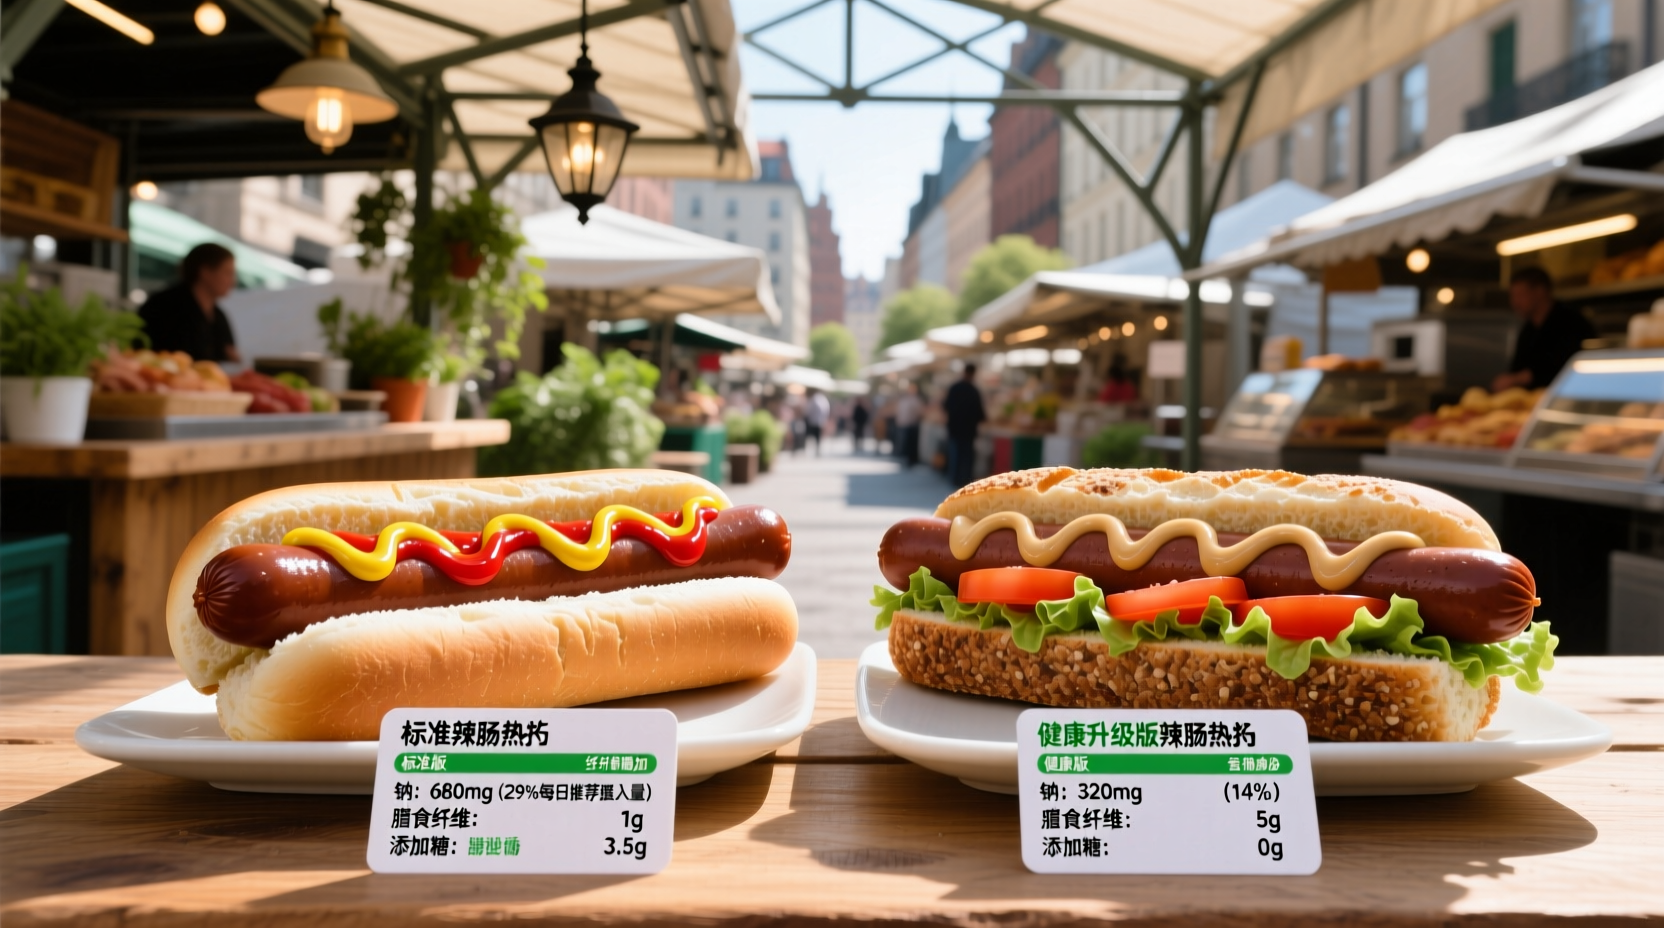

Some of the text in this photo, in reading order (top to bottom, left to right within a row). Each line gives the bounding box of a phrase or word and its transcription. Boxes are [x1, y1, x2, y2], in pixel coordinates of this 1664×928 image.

[430, 783, 493, 804] 680mg
[1078, 783, 1142, 805] 320mg
[1224, 782, 1279, 803] (14%)
[622, 811, 643, 833] 1g
[1257, 810, 1280, 833] 5g
[604, 837, 646, 860] 3.5g
[1258, 838, 1283, 861] 0g
